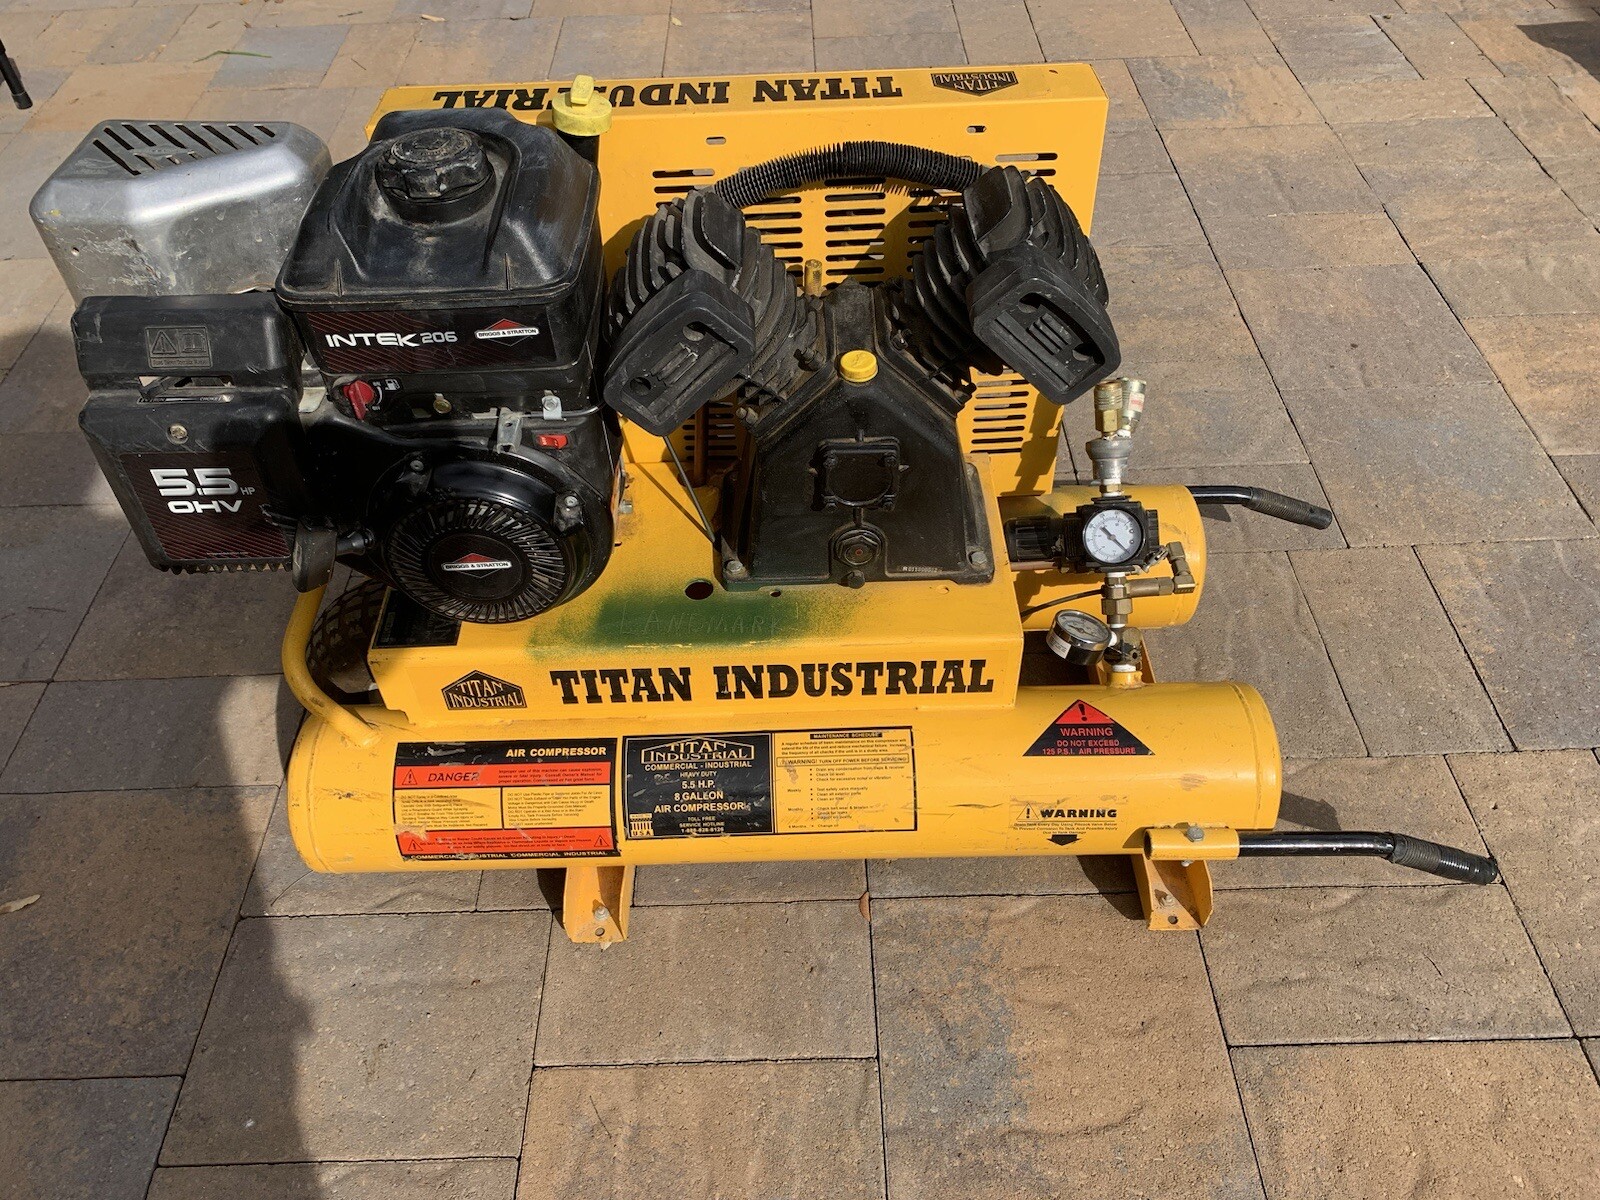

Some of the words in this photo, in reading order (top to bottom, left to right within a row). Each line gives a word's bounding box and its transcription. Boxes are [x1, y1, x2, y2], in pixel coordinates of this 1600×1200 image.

[936, 72, 1011, 83] INDUSTRIAL
[432, 81, 730, 110] INDURIAL
[752, 76, 903, 102] TITAN
[325, 332, 420, 347] INTEK
[420, 331, 458, 343] 206
[149, 467, 239, 497] 5.5
[240, 487, 256, 496] HP
[167, 500, 242, 514] OHV
[455, 678, 505, 698] TITAN
[549, 666, 693, 705] TITAN
[712, 658, 994, 701] INDUSTRIAL
[449, 692, 524, 708] INDUSTRIAL
[1060, 727, 1113, 737] WARNING
[666, 740, 727, 754] TITAN
[1088, 739, 1119, 747] EXCEED
[506, 748, 526, 758] AIR
[530, 746, 607, 757] COMPRESSOR
[649, 748, 748, 762] INDUSTRIAL
[645, 763, 698, 771] COMMERCIAL
[705, 761, 752, 769] INDUSTRIAL
[427, 771, 480, 782] DANGER
[682, 780, 696, 789] 5.5
[698, 780, 716, 789] H.P.
[674, 792, 681, 801] 8
[682, 791, 724, 801] GALLON
[654, 805, 671, 813] AIR
[673, 802, 745, 813] COMPRESSOR
[1040, 809, 1117, 818] WARNING
